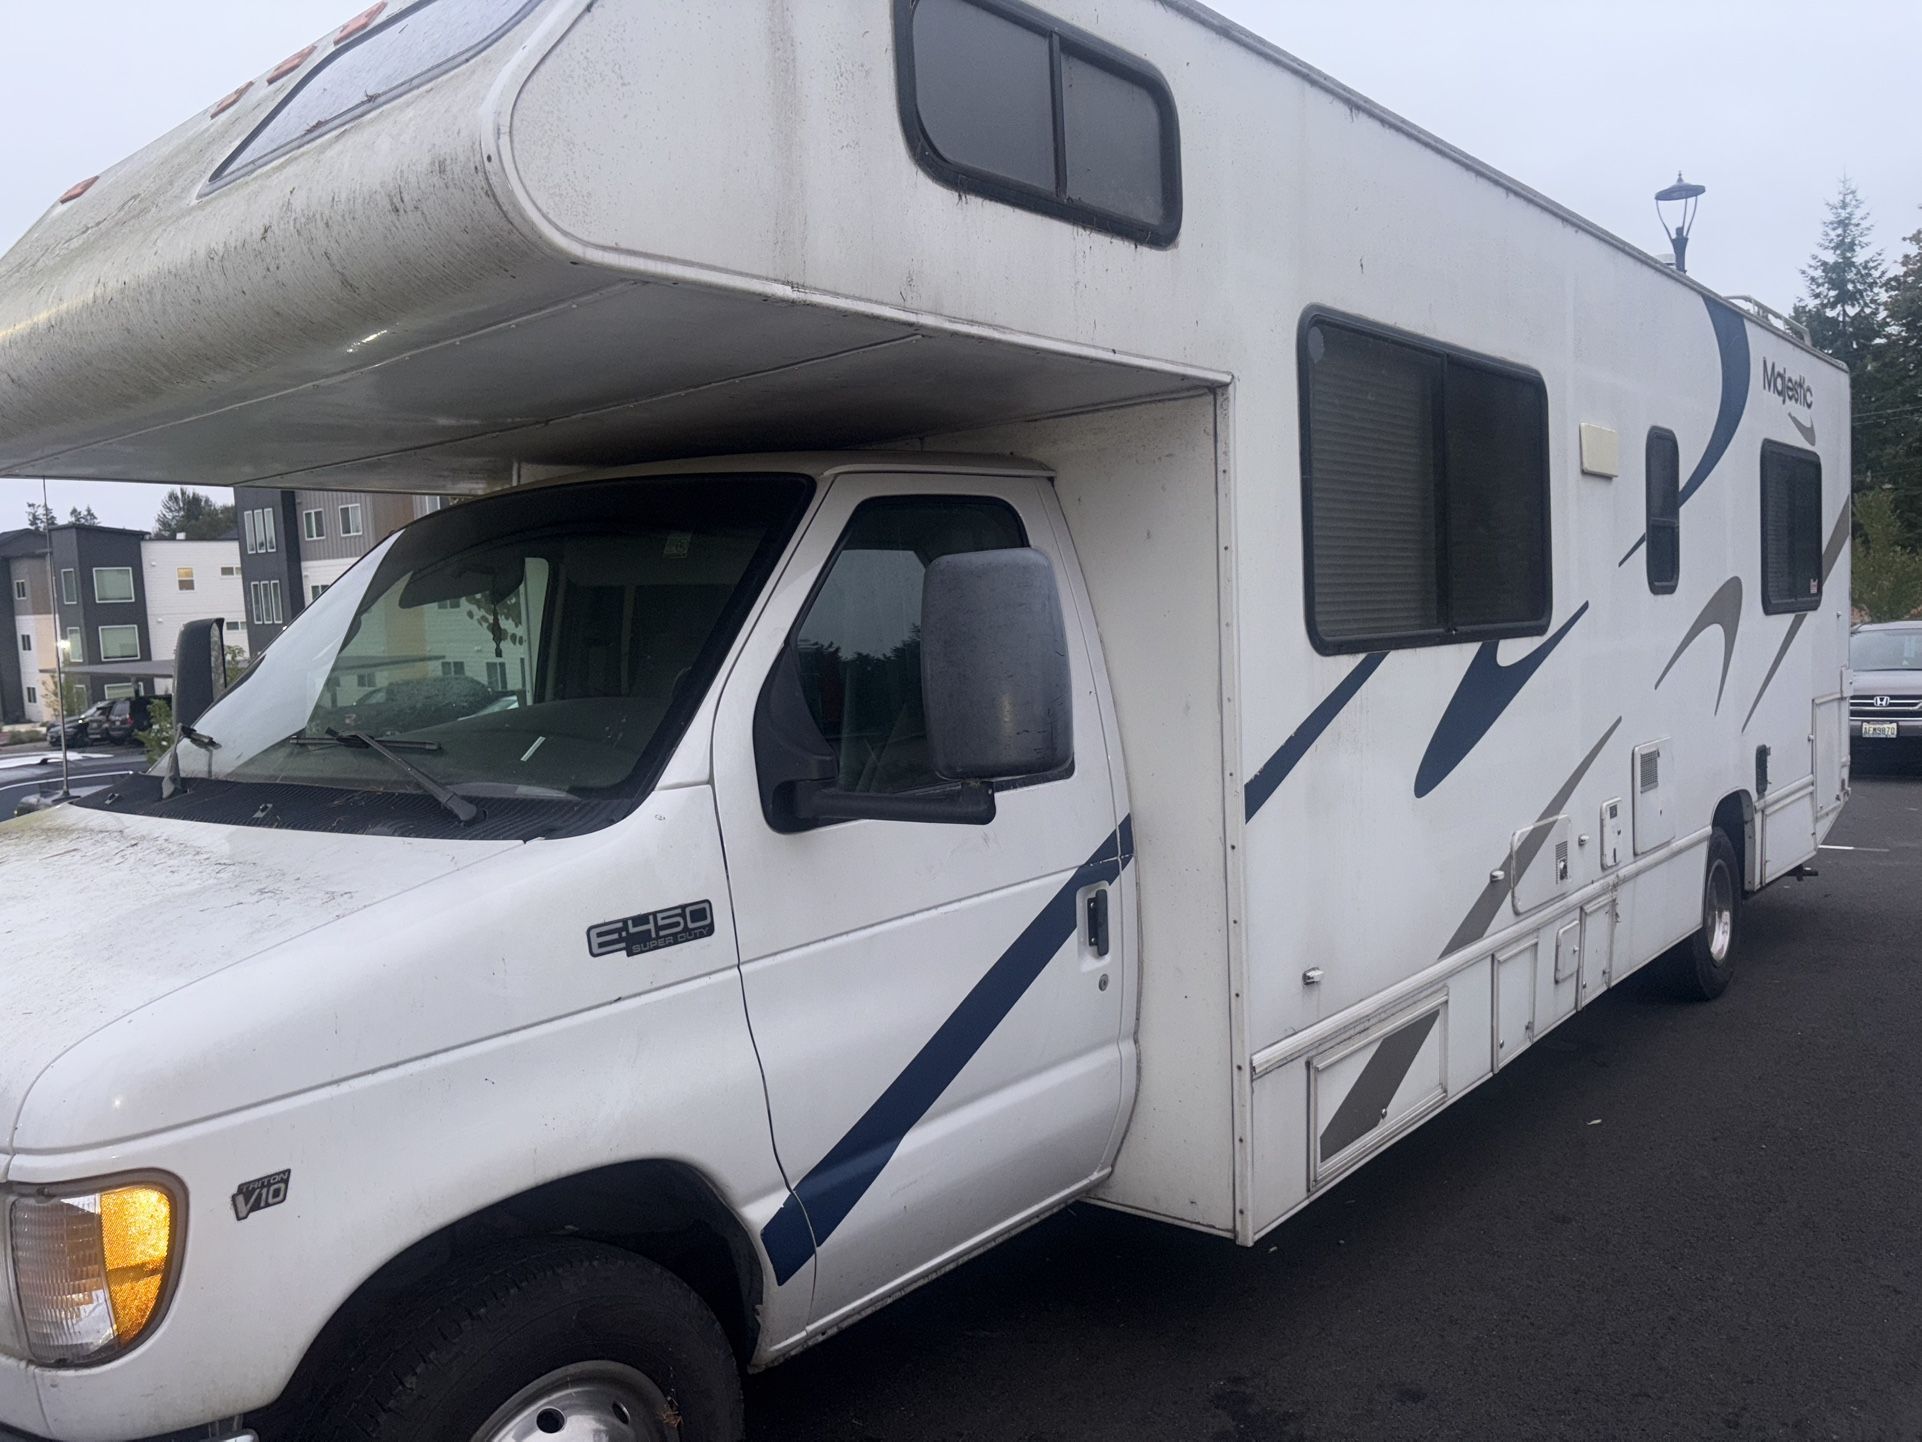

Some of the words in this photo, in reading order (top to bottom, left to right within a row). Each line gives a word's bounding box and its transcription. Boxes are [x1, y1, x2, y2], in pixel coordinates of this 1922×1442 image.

[1762, 356, 1813, 410] Majestic
[631, 936, 674, 953] SUPER
[677, 928, 709, 942] DUTY
[240, 1170, 289, 1192] TRITON
[234, 1182, 286, 1219] V10
